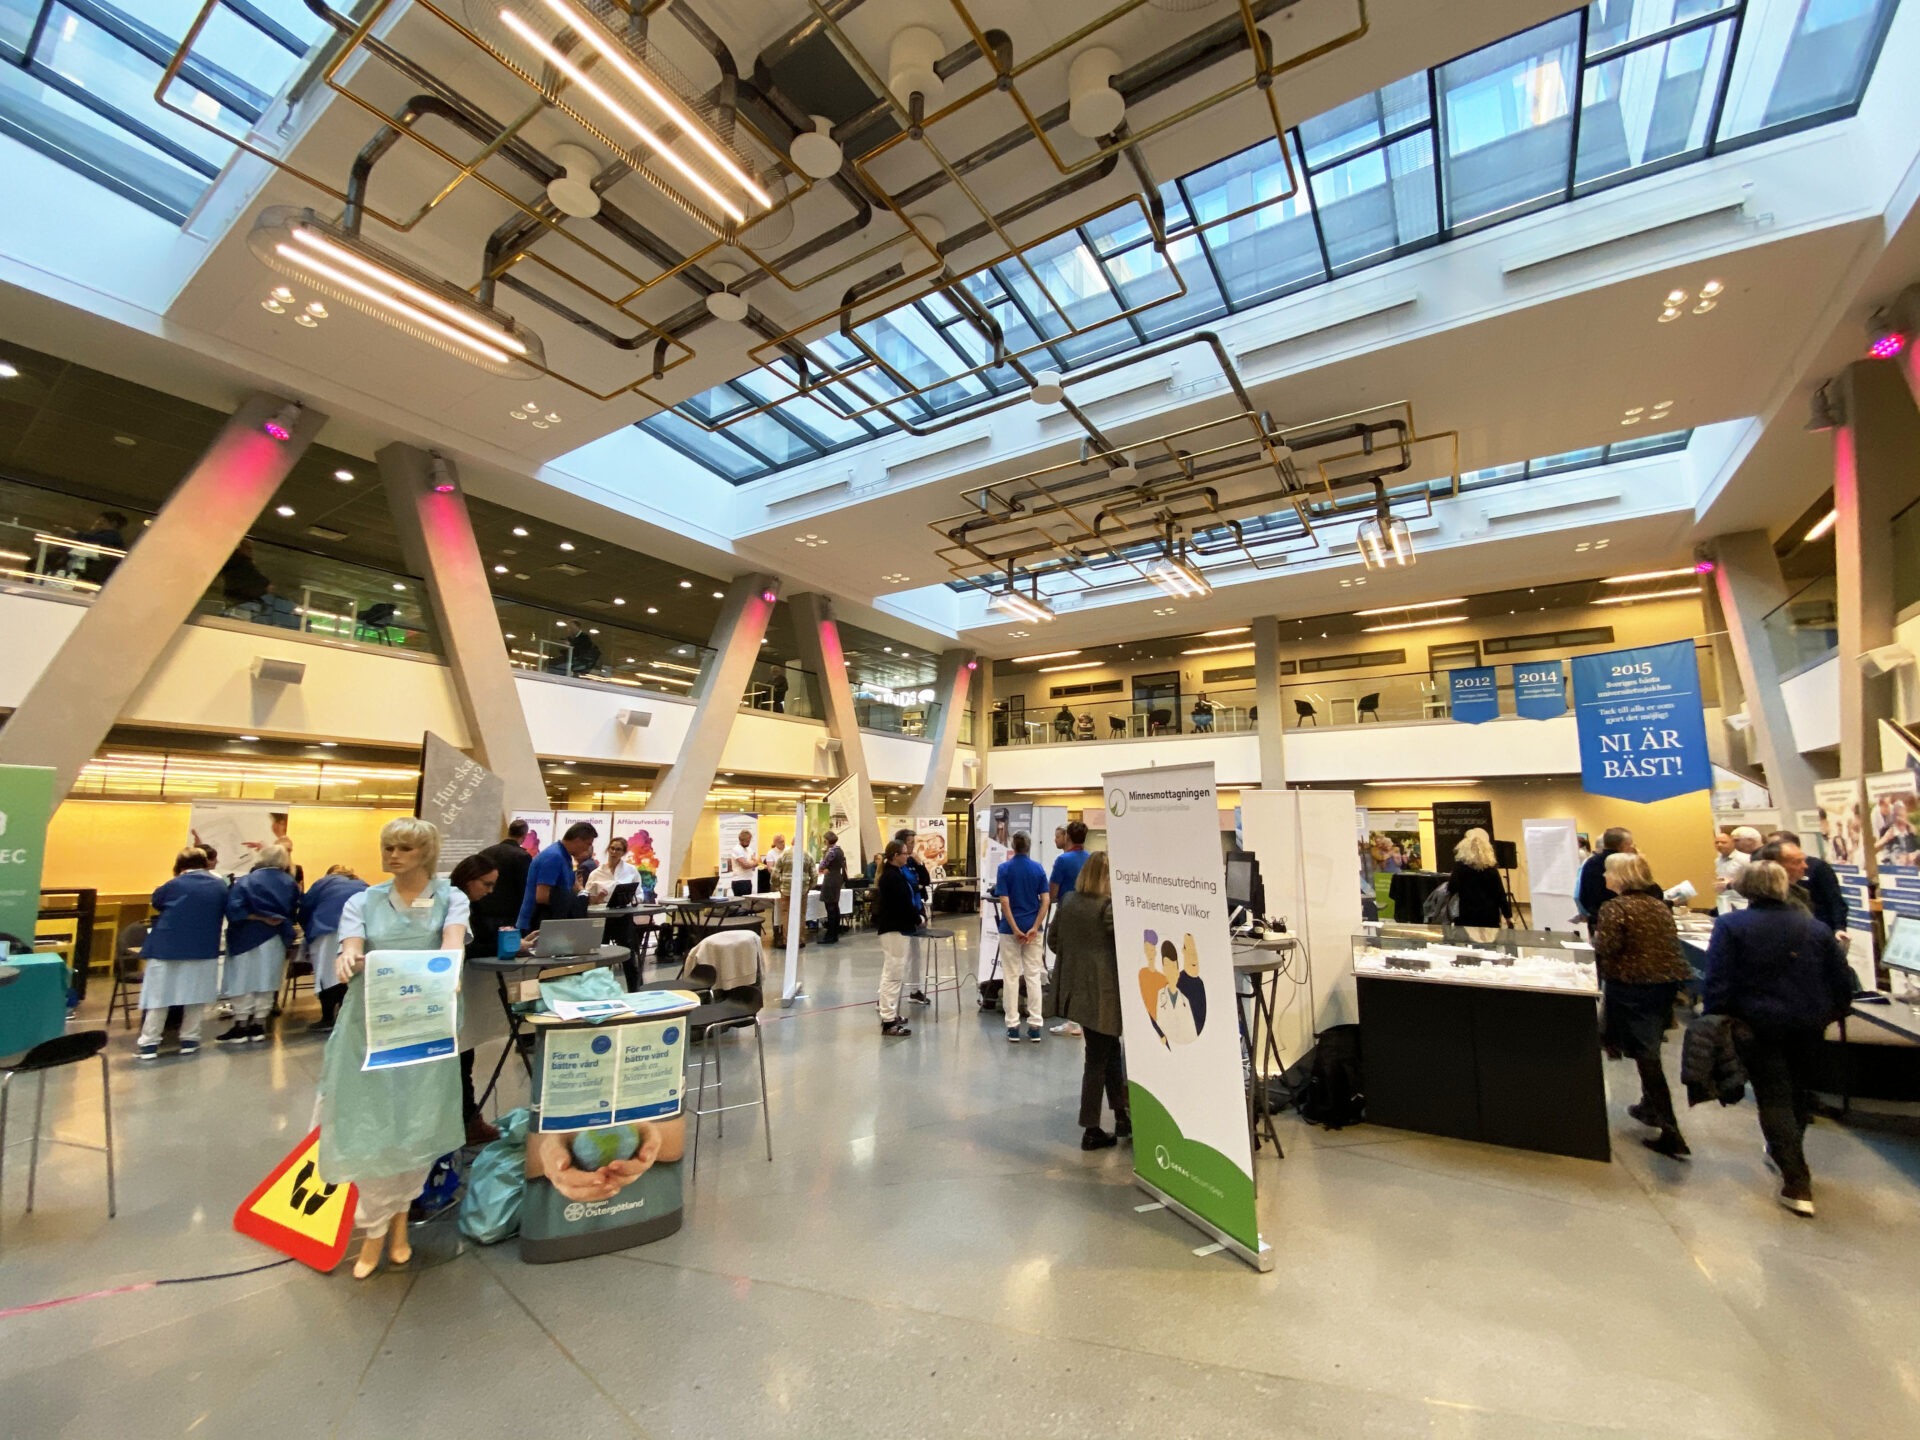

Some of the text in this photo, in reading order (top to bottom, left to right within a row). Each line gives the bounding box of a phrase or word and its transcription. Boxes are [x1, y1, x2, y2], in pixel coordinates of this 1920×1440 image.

[1611, 662, 1653, 677] 2015
[1455, 677, 1491, 688] 2012
[1519, 671, 1558, 683] 2014
[1598, 726, 1684, 753] NI ÄR
[1602, 754, 1683, 779] BÄST!
[432, 759, 476, 807] Hur ska
[441, 803, 465, 825] det
[458, 787, 473, 804] se
[468, 766, 487, 787] ut?
[1128, 788, 1210, 801] Minnesmottagningen
[516, 816, 550, 826] Fansiering
[616, 818, 670, 826] Affärsutveckling
[928, 819, 944, 827] PEA
[1115, 869, 1217, 895] Digital Minnesutredning
[1125, 895, 1211, 920] På Patientens Villkor
[400, 984, 422, 996] 34%
[552, 1051, 580, 1060] För en
[625, 1044, 652, 1054] För en
[624, 1049, 669, 1064] bättre vård
[551, 1059, 599, 1070] bättre vård
[585, 1197, 644, 1218] Östergötland
